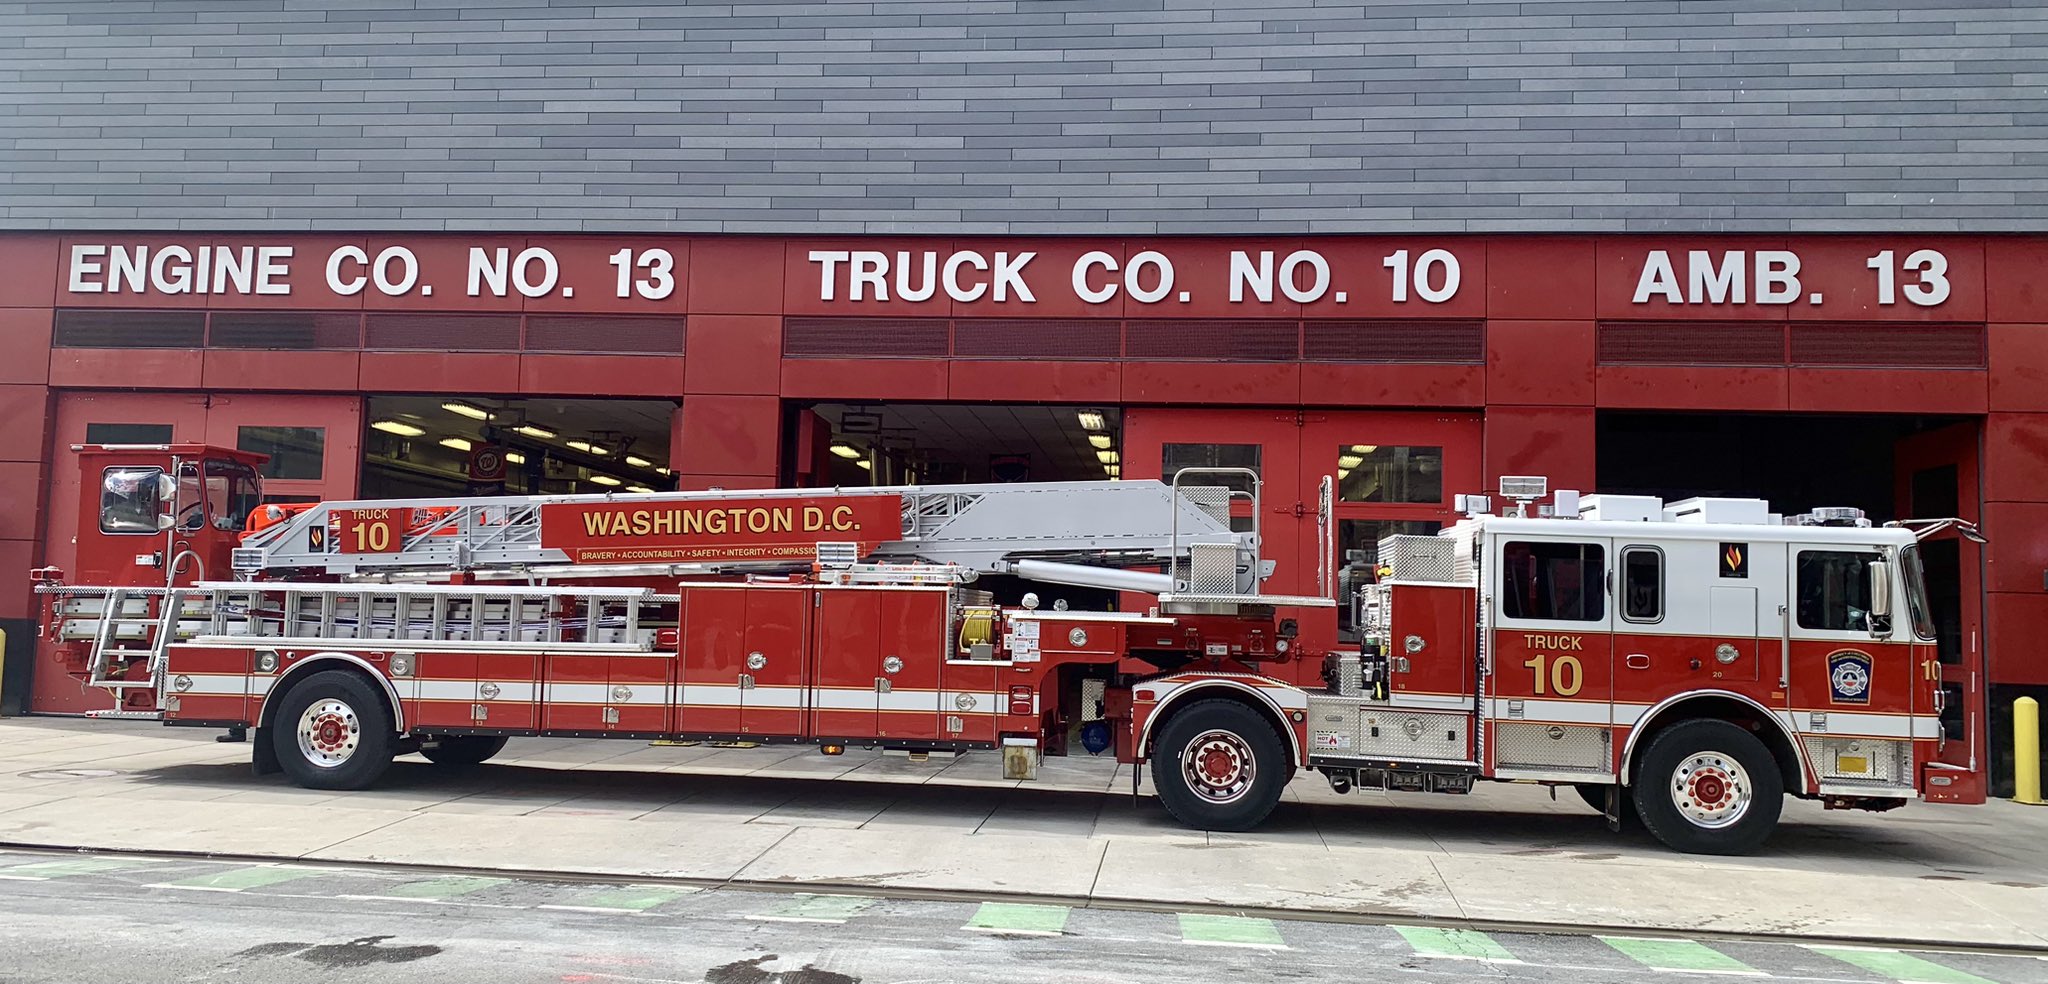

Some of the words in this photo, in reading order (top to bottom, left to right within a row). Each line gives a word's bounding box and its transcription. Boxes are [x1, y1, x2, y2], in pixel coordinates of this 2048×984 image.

[67, 245, 294, 295] ENGINE
[325, 245, 432, 296] CO.
[466, 247, 574, 298] NO.
[609, 248, 675, 300] 13
[808, 250, 1037, 302] TRUCK
[1071, 250, 1191, 303] CO.
[1229, 249, 1347, 303] NO.
[1383, 248, 1461, 303] 10
[1631, 250, 1823, 304] AMB.
[1866, 249, 1951, 306] 13
[351, 509, 389, 520] TRUCK
[583, 507, 793, 536] WASHINGTON
[803, 505, 861, 531] D.C.
[351, 521, 390, 551] 10
[581, 551, 616, 560] BRAVERY
[621, 549, 685, 559] ACCOUNTABILITY
[691, 548, 721, 558] SAFETY
[726, 547, 766, 557] INTEGRITY
[772, 546, 817, 556] COMPASSIO
[1524, 634, 1583, 651] TRUCK
[1523, 654, 1583, 696] 10
[1920, 659, 1939, 681] 10
